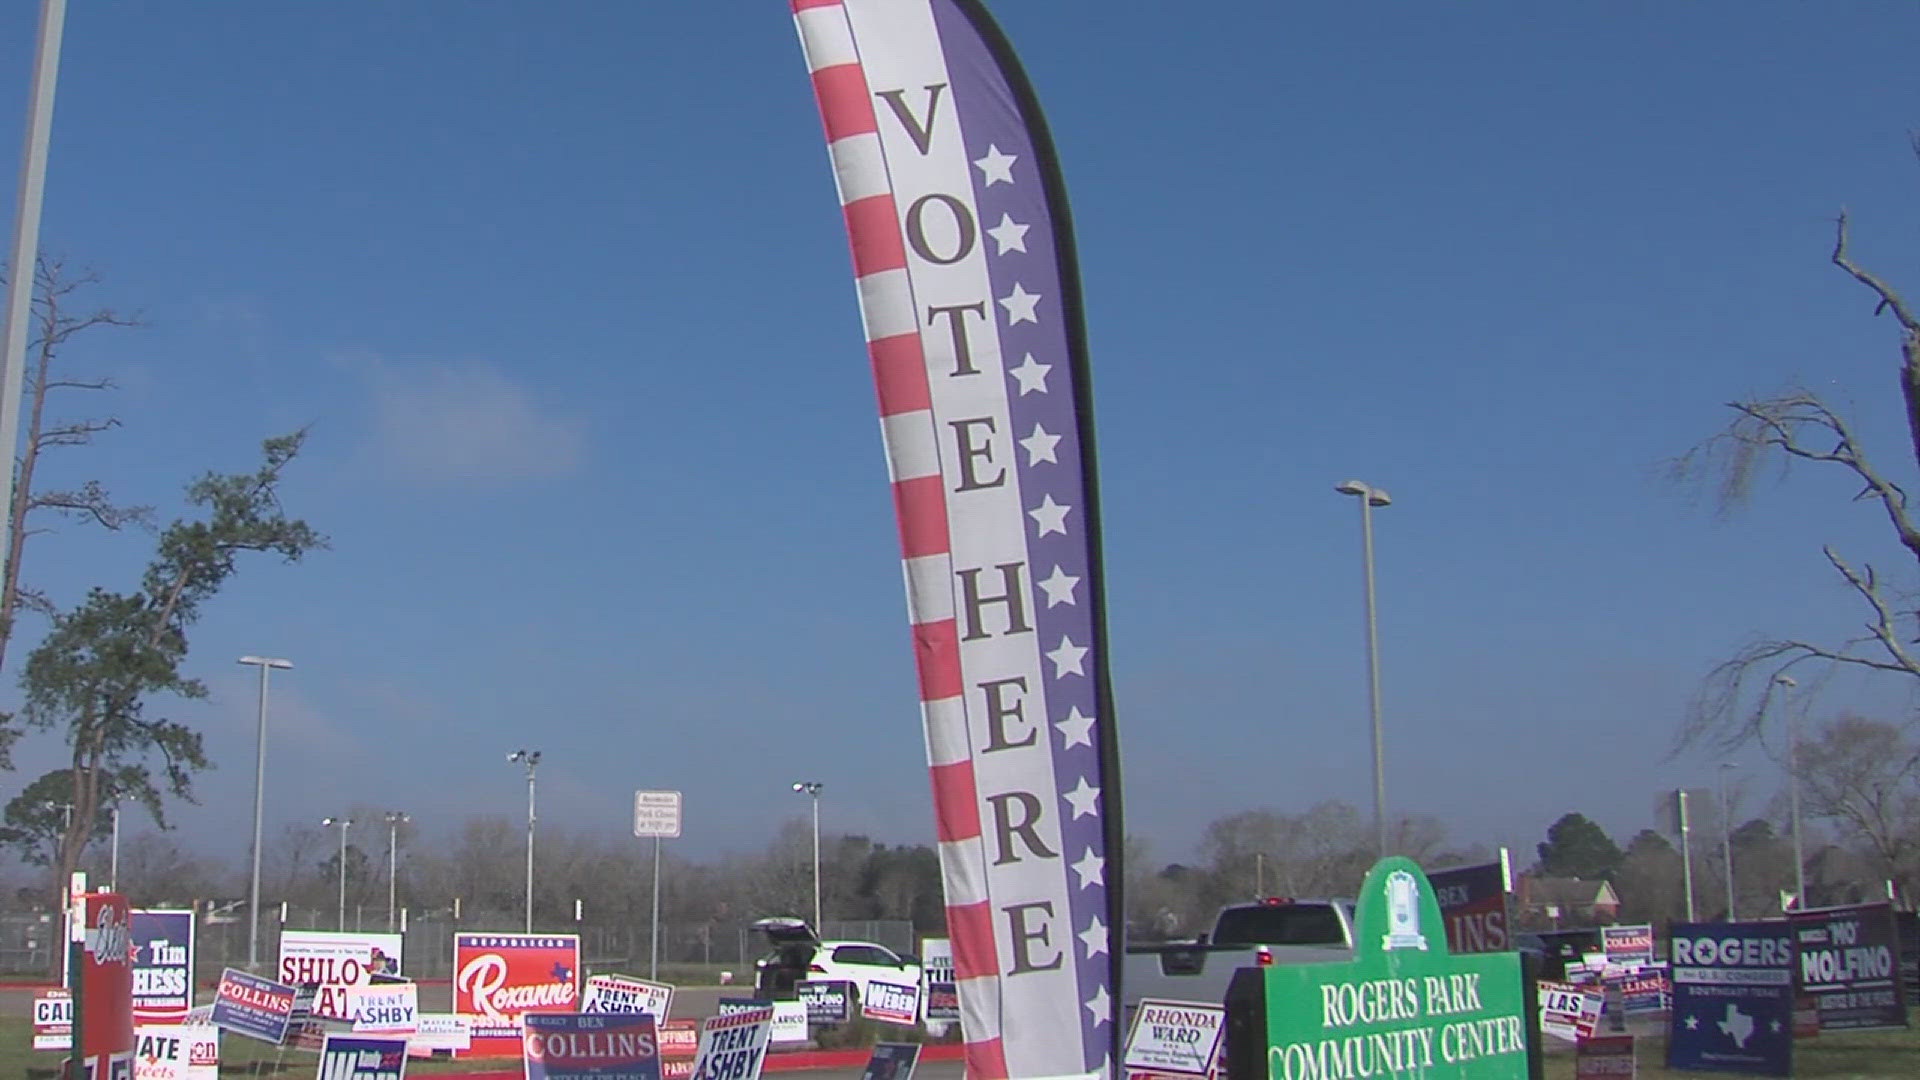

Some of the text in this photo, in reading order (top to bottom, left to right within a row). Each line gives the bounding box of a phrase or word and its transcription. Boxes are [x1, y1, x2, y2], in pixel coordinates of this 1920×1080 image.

[875, 83, 1005, 493] VOTE
[956, 561, 1063, 978] HERE
[149, 940, 186, 965] Tim
[1672, 937, 1791, 965] ROGERS
[1801, 945, 1891, 983] MOLFINO
[132, 968, 186, 995] HESS
[283, 957, 359, 985] SHILO
[220, 981, 290, 1013] COLLINS
[359, 994, 404, 1006] TRENT
[459, 953, 575, 1019] Roxanne
[597, 988, 639, 1004] TRENT
[868, 983, 915, 1011] WEBER
[1320, 973, 1483, 1028] ROGERS PARK
[353, 1007, 414, 1025] ASHBY
[578, 1017, 605, 1029] BEN
[1144, 1009, 1217, 1029] RHONDA
[526, 1033, 655, 1058] COLLINS
[710, 1025, 760, 1053] TRENT
[1153, 1026, 1201, 1043] WARD
[1268, 1016, 1525, 1080] COMMUNITY CENTER
[695, 1047, 762, 1080] ASHBY
